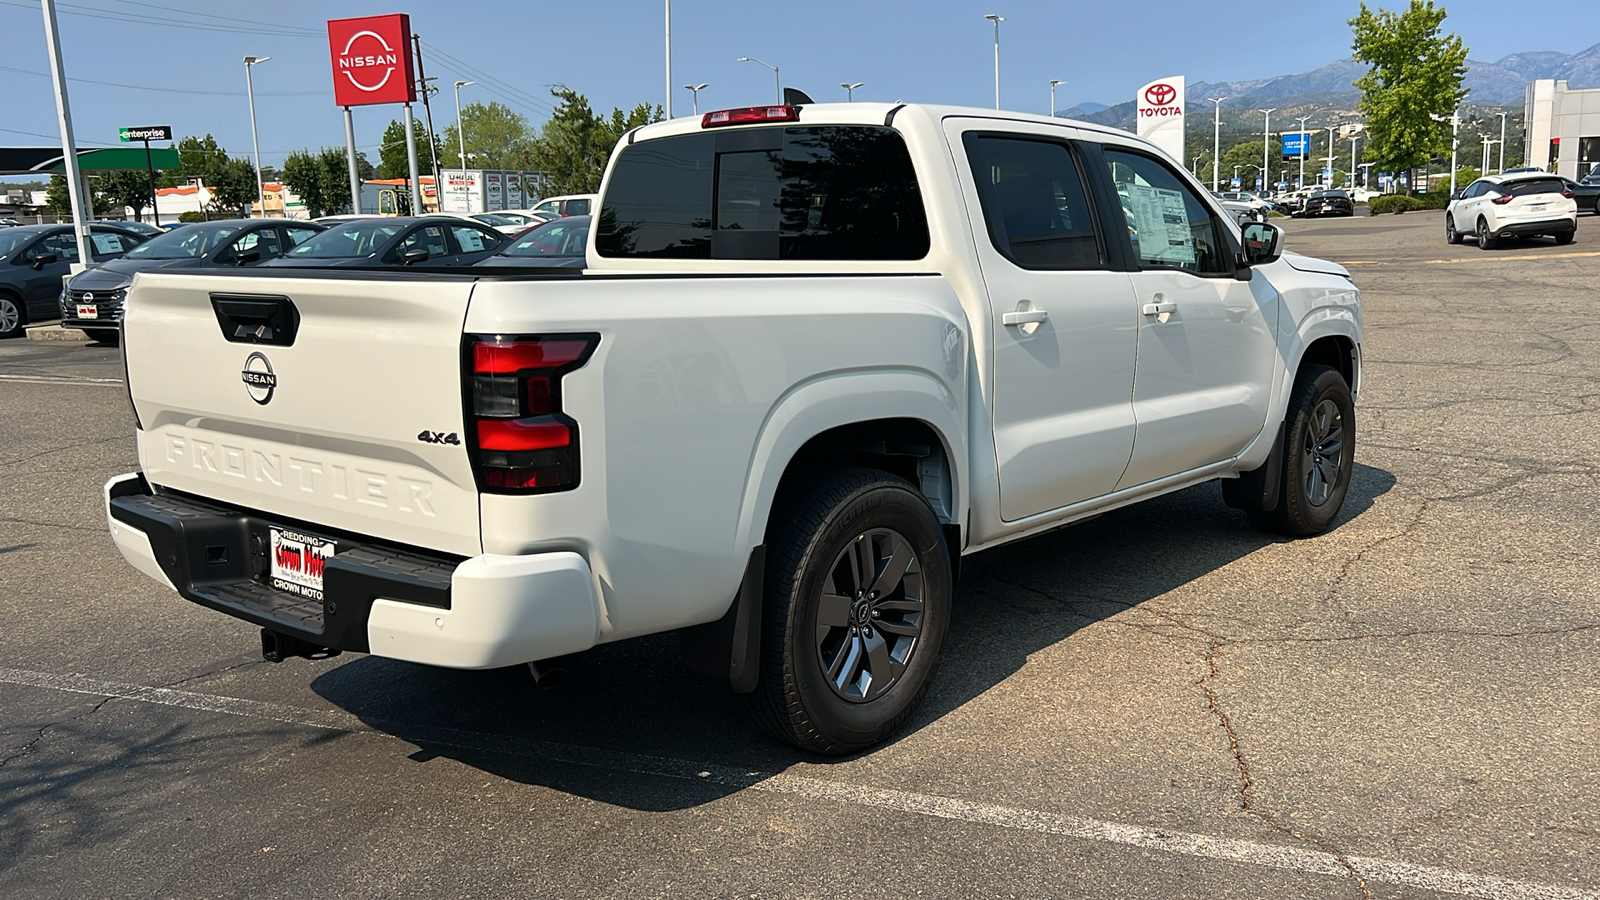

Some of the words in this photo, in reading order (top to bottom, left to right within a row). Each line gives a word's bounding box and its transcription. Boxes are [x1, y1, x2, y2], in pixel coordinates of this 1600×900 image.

[339, 54, 397, 69] NISSAN
[1139, 106, 1182, 118] TOYOTA
[122, 129, 165, 140] enterprise
[242, 372, 274, 384] NISSAN
[164, 432, 437, 517] FRONTIER
[283, 530, 319, 546] REDDING
[275, 544, 301, 573] Crown
[274, 578, 300, 594] CROWN
[301, 586, 324, 600] MOTO
